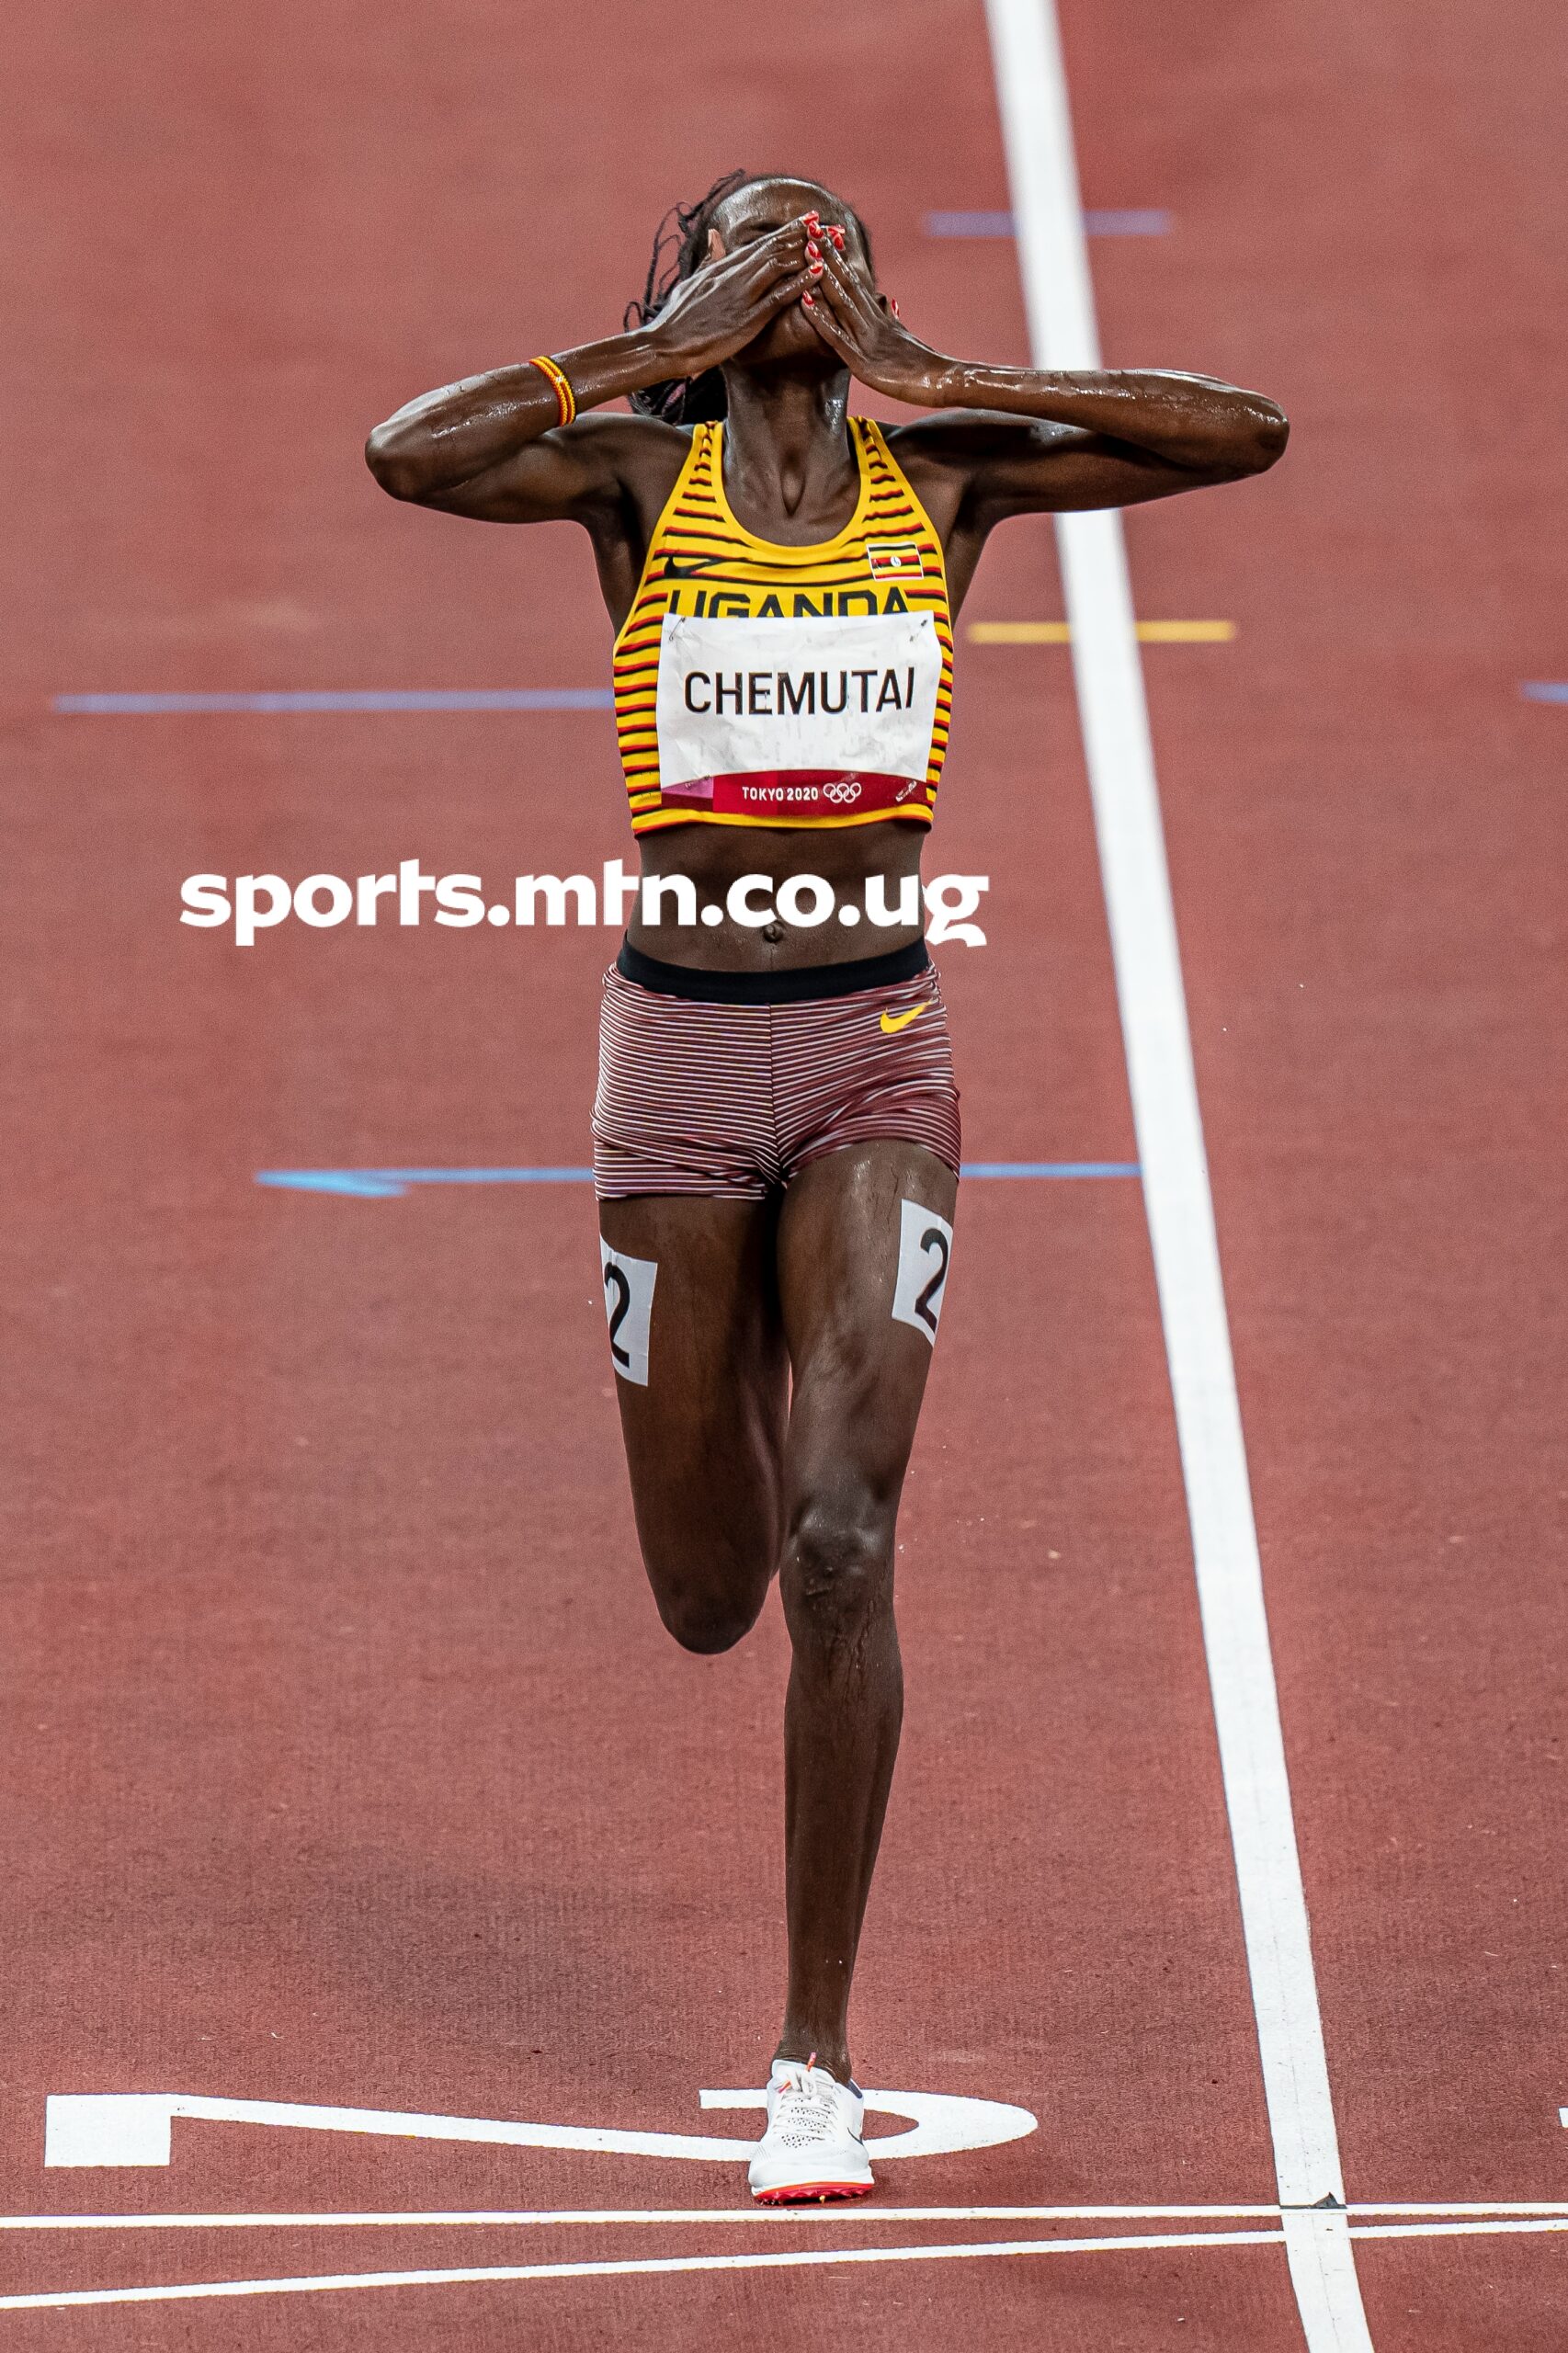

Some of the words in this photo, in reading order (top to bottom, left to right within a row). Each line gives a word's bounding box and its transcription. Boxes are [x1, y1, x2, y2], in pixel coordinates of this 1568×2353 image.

[685, 667, 915, 715] CHEMUTAI
[742, 786, 783, 801] TOKYO
[786, 786, 818, 801] 2020
[604, 1261, 631, 1369] 2
[915, 1227, 949, 1334] 2
